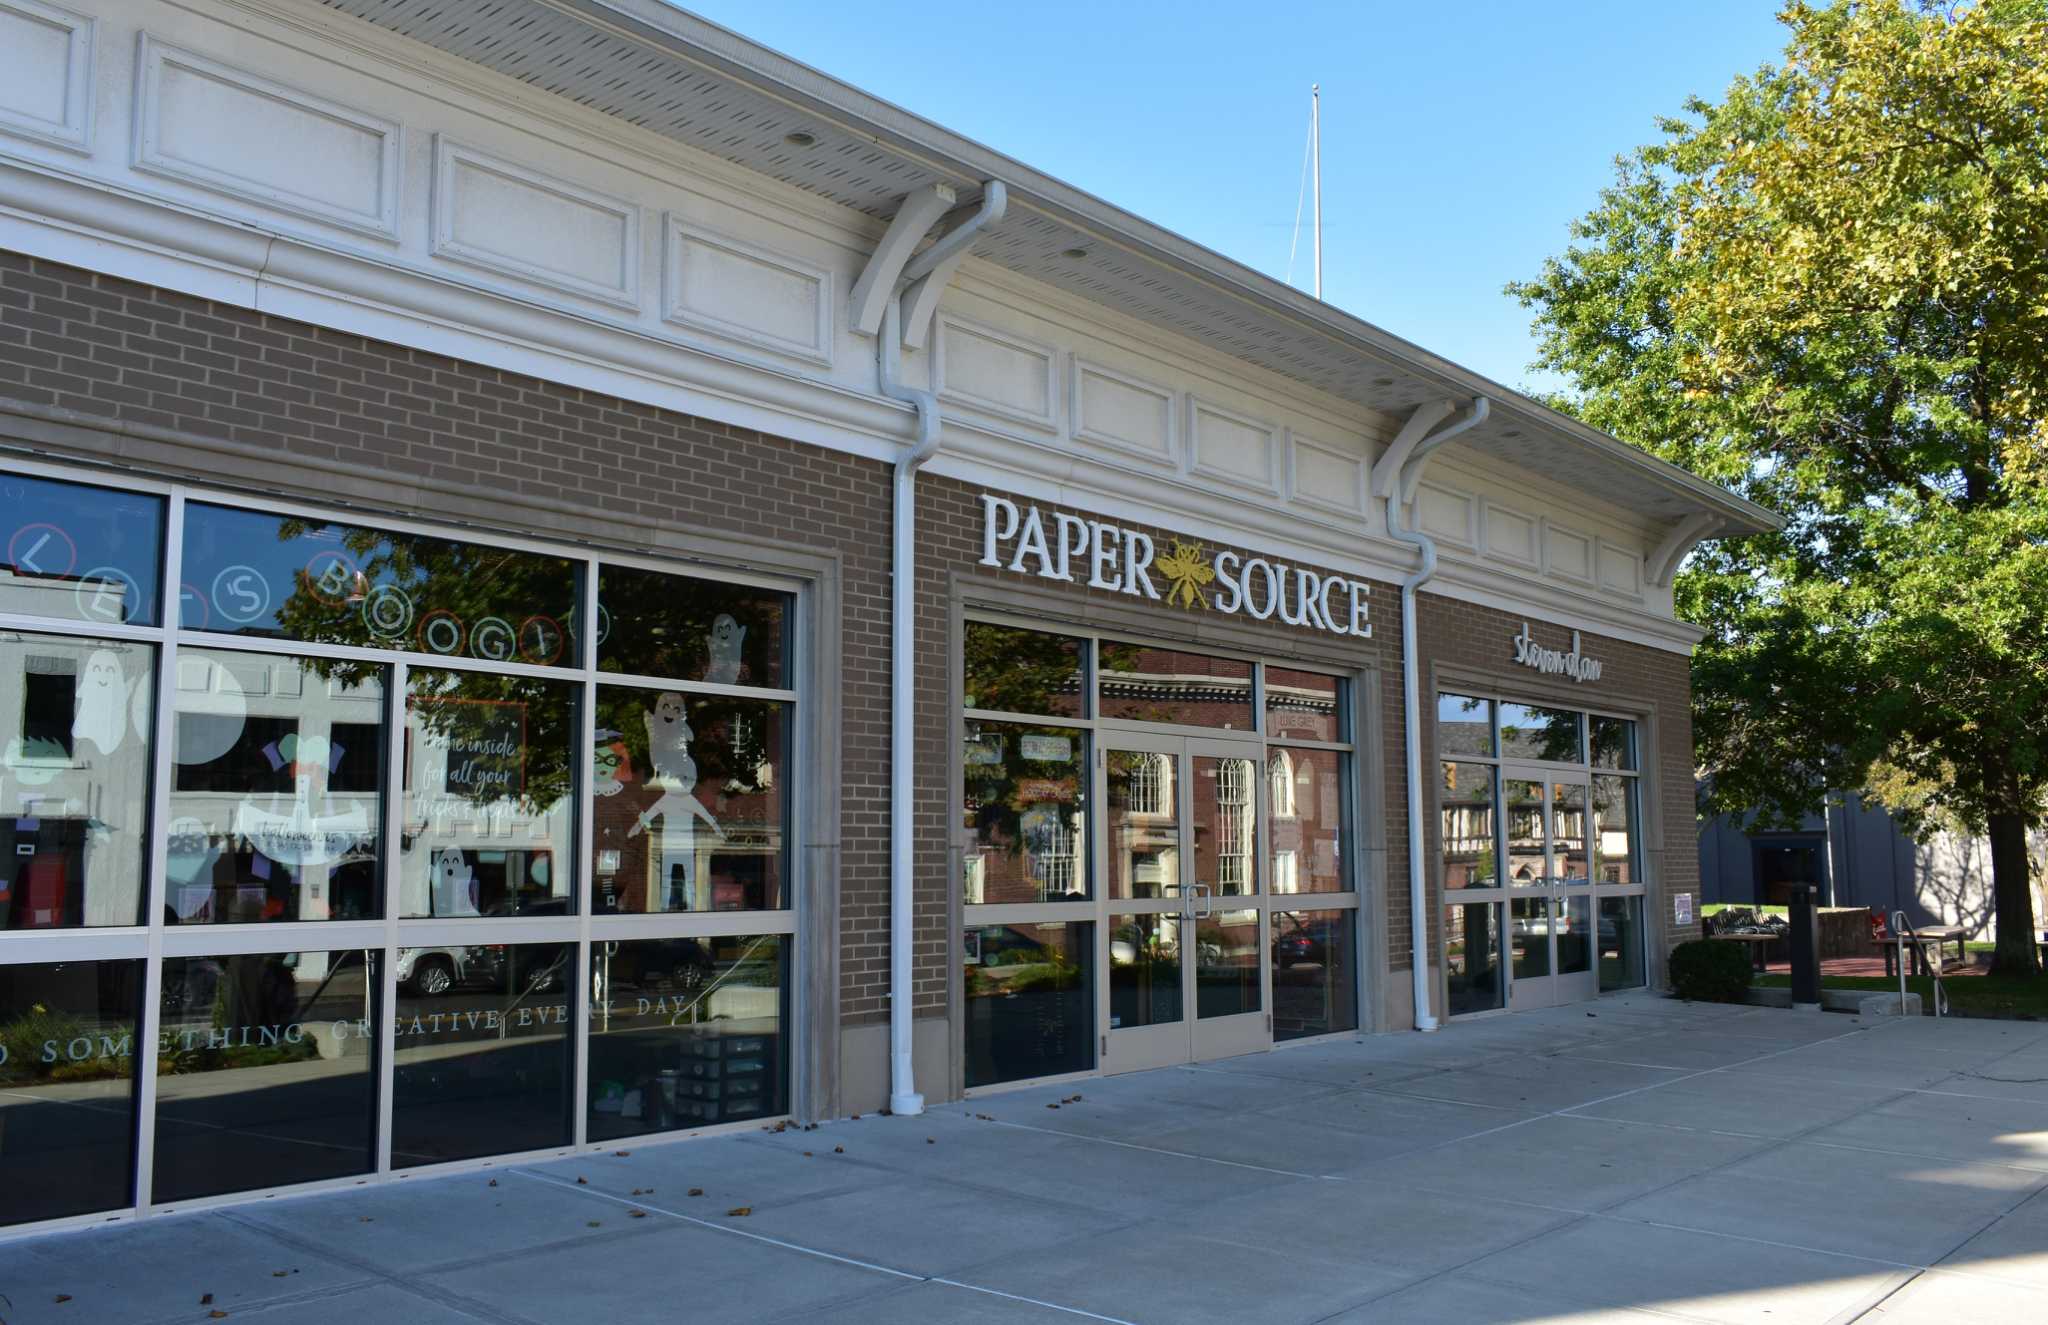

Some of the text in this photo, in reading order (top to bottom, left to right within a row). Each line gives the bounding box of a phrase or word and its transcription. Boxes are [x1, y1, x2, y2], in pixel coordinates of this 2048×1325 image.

[978, 494, 1373, 639] PAPER SOURCE
[317, 559, 603, 660] BOOGI
[423, 759, 512, 795] for all your
[468, 732, 516, 757] inside
[42, 1022, 304, 1062] SOMETHING
[331, 1009, 500, 1039] CREATIVE
[636, 995, 685, 1016] DAY
